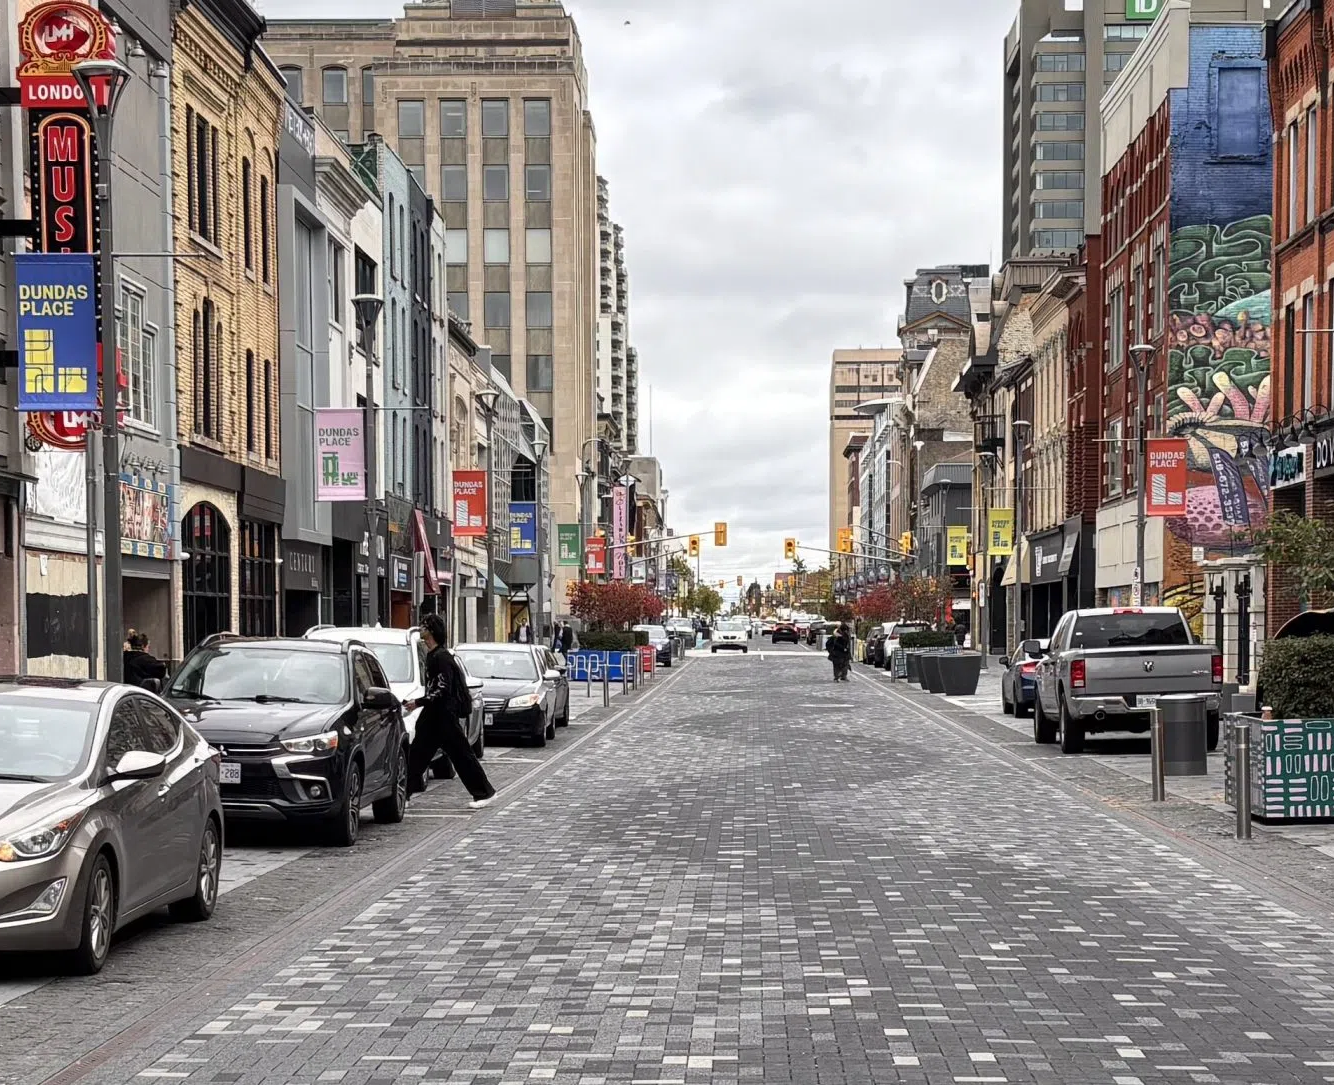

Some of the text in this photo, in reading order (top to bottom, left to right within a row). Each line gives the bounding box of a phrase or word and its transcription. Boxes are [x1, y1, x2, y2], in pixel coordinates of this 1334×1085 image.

[47, 126, 78, 254] MUS
[19, 285, 88, 299] DUNDAS
[19, 301, 75, 316] PLACE
[318, 428, 359, 437] DUNDAS
[319, 438, 351, 446] PLACE
[1149, 451, 1186, 460] DUNDAS
[1149, 459, 1178, 468] PLACE
